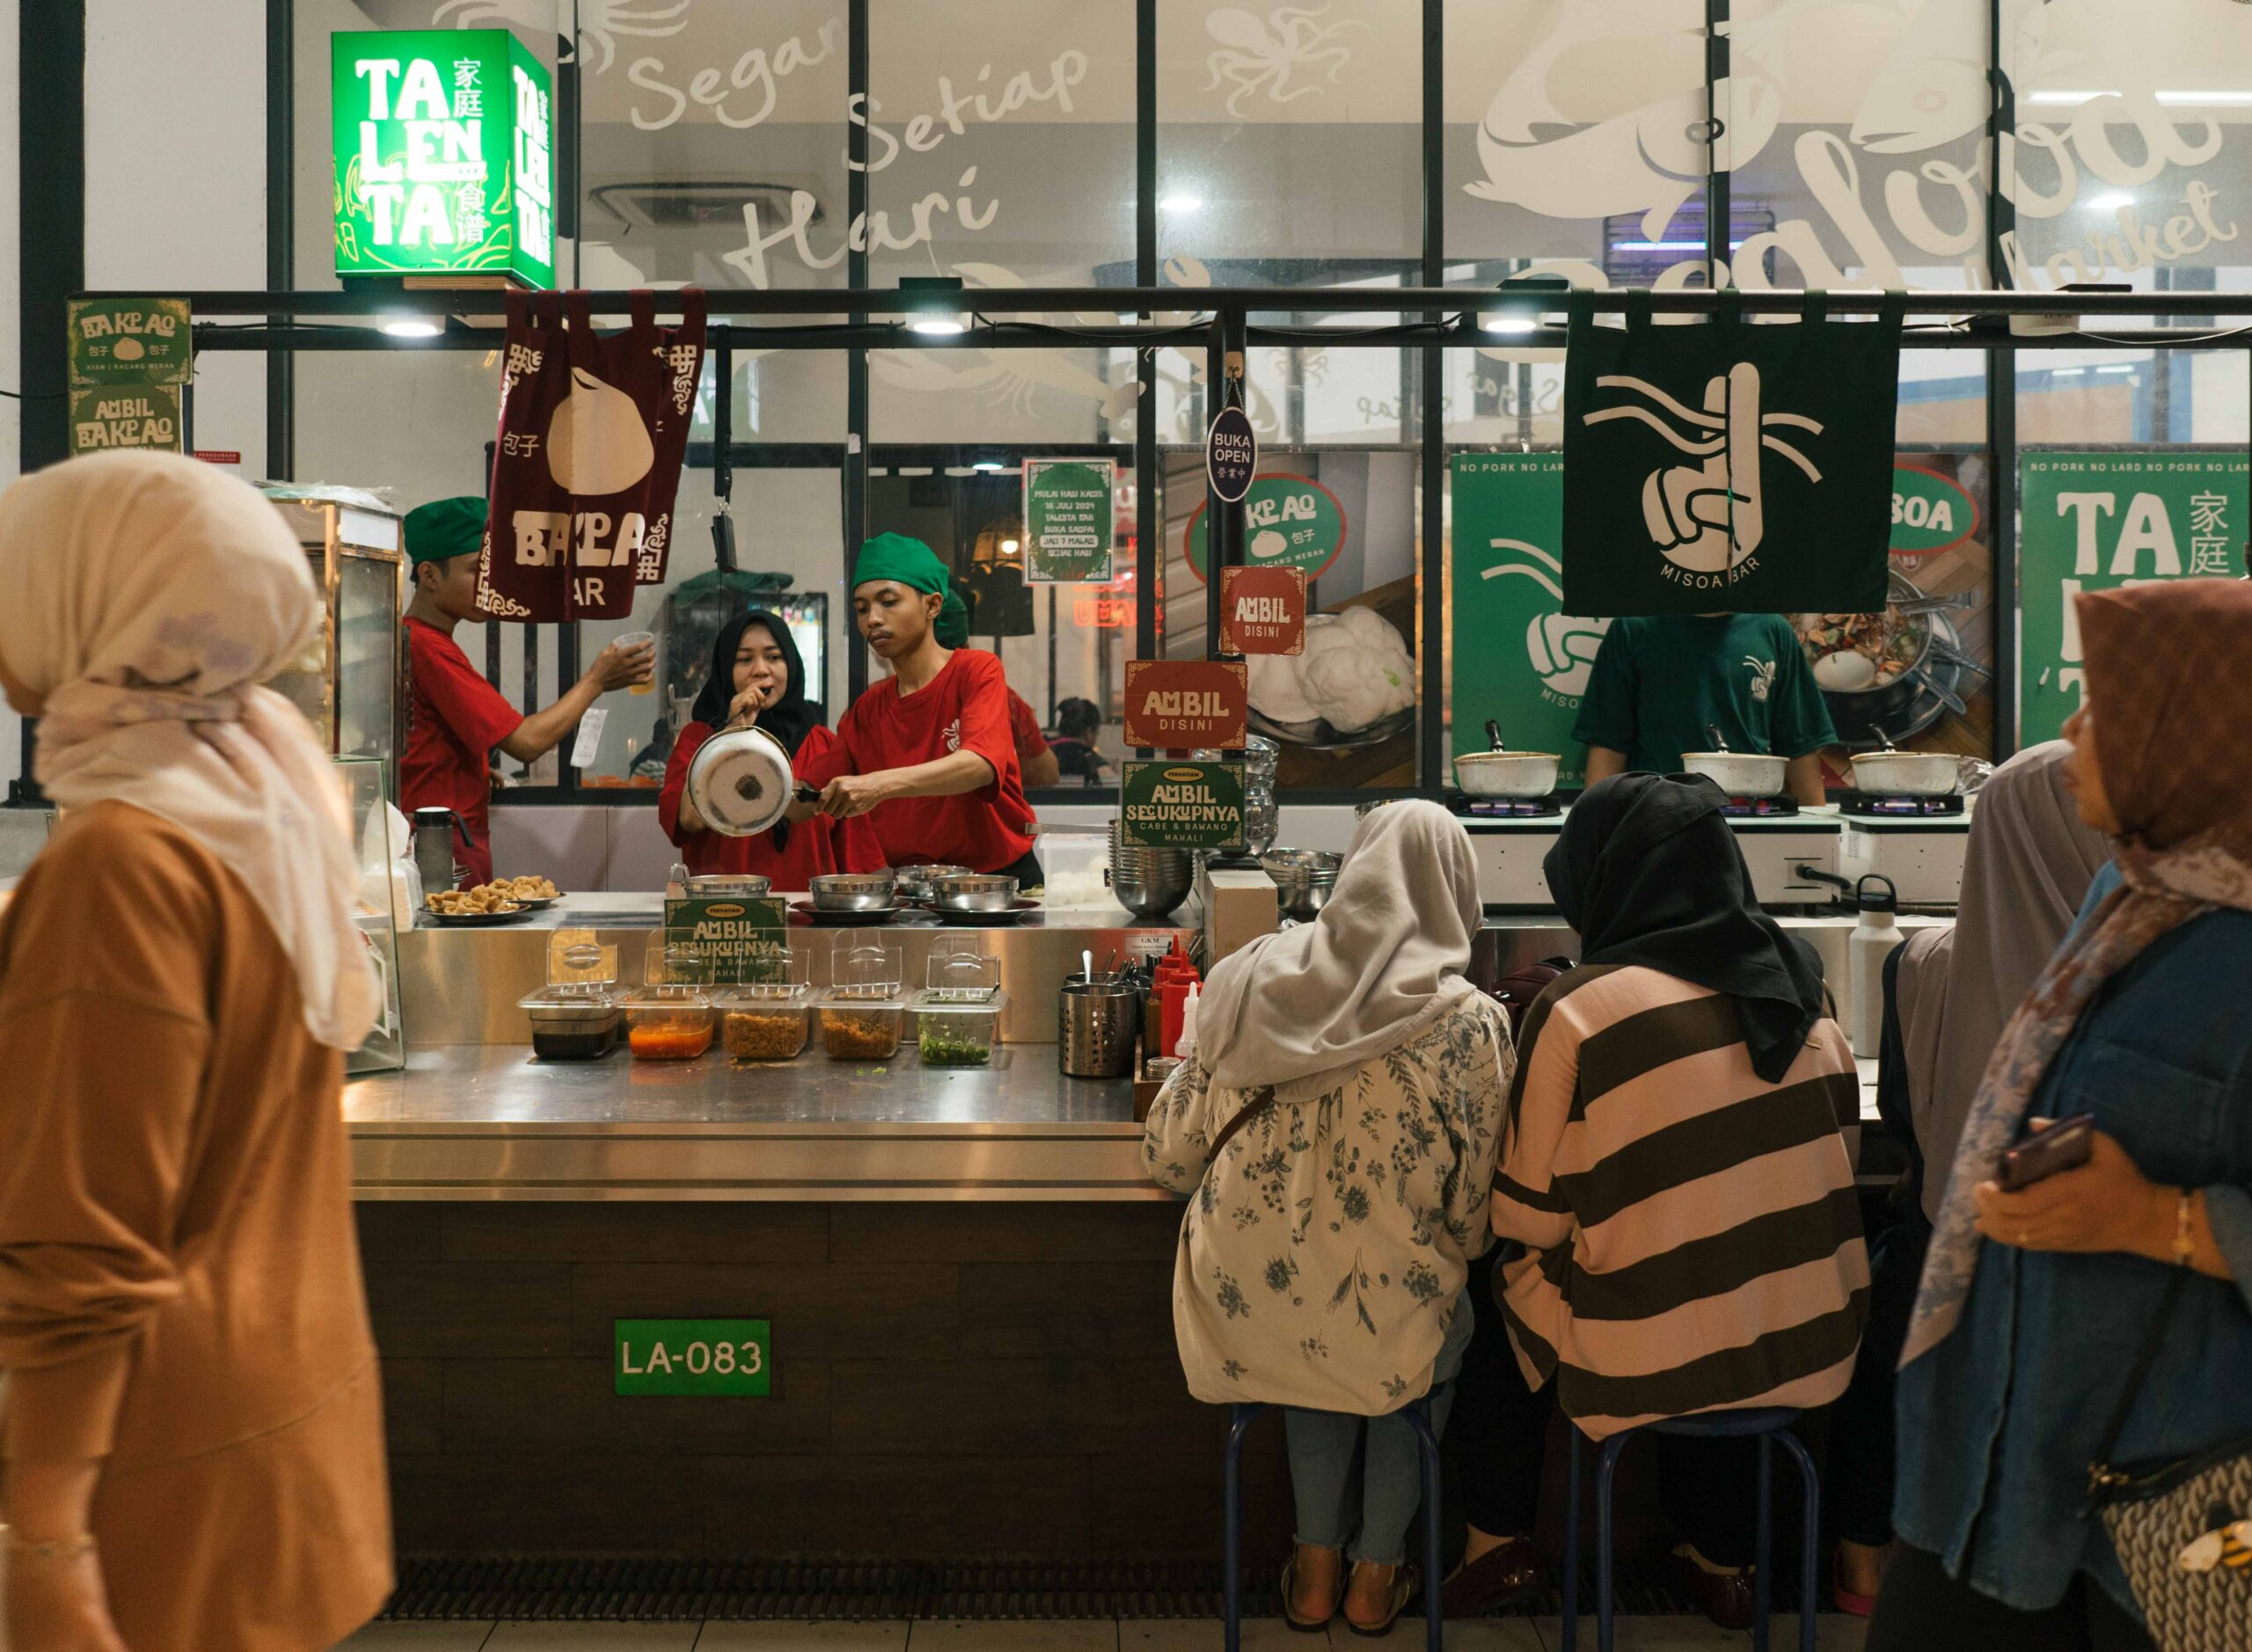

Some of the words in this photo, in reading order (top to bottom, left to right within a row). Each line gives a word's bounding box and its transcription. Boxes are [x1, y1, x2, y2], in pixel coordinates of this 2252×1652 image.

[453, 57, 484, 118] 家庭
[628, 18, 847, 130] Segar
[355, 58, 450, 120] TA
[842, 49, 1088, 172] Setiap
[359, 120, 487, 182] LEN
[359, 184, 454, 245] TA
[457, 183, 486, 244] 食谱
[722, 165, 999, 290] Hari
[80, 312, 176, 340] BAKPAO
[89, 346, 110, 356] 包子
[149, 345, 170, 355] 包子
[95, 398, 154, 420] AMBIL
[76, 417, 174, 448] BAKPAO
[502, 430, 539, 457] 包子
[1214, 433, 1251, 448] BUKA
[1215, 449, 1251, 464] OPEN
[1459, 464, 1476, 472] NO
[1482, 464, 1516, 472] PORK
[1543, 463, 1564, 471] LAR
[2030, 463, 2047, 471] NO
[2052, 463, 2085, 471] PORK
[2090, 463, 2106, 471] NO
[2111, 463, 2141, 471] LARD
[2146, 463, 2163, 471] NO
[2168, 463, 2201, 471] PORK
[2207, 463, 2223, 471] NO
[2228, 463, 2250, 471] LAR
[1246, 494, 1317, 530] KPAO
[1890, 493, 1953, 532] SOA
[1291, 529, 1315, 545] 包子
[2057, 492, 2182, 575] TA
[2188, 490, 2230, 574] 家庭
[1259, 557, 1291, 567] ACANG
[1660, 564, 1723, 589] MISOA
[1732, 557, 1760, 582] BAR
[574, 577, 606, 606] AR
[1235, 596, 1291, 624] AMBIL
[1245, 625, 1279, 638] DISINI
[1142, 691, 1229, 717] AMBIL
[1540, 689, 1579, 709] MISO
[1159, 719, 1212, 731] DISINI
[1558, 771, 1573, 780] RD
[1151, 785, 1217, 804] AMBIL
[1126, 805, 1239, 822] SECUKUPNYA
[693, 921, 758, 939] AMBIL
[623, 1341, 762, 1374] LA-083
